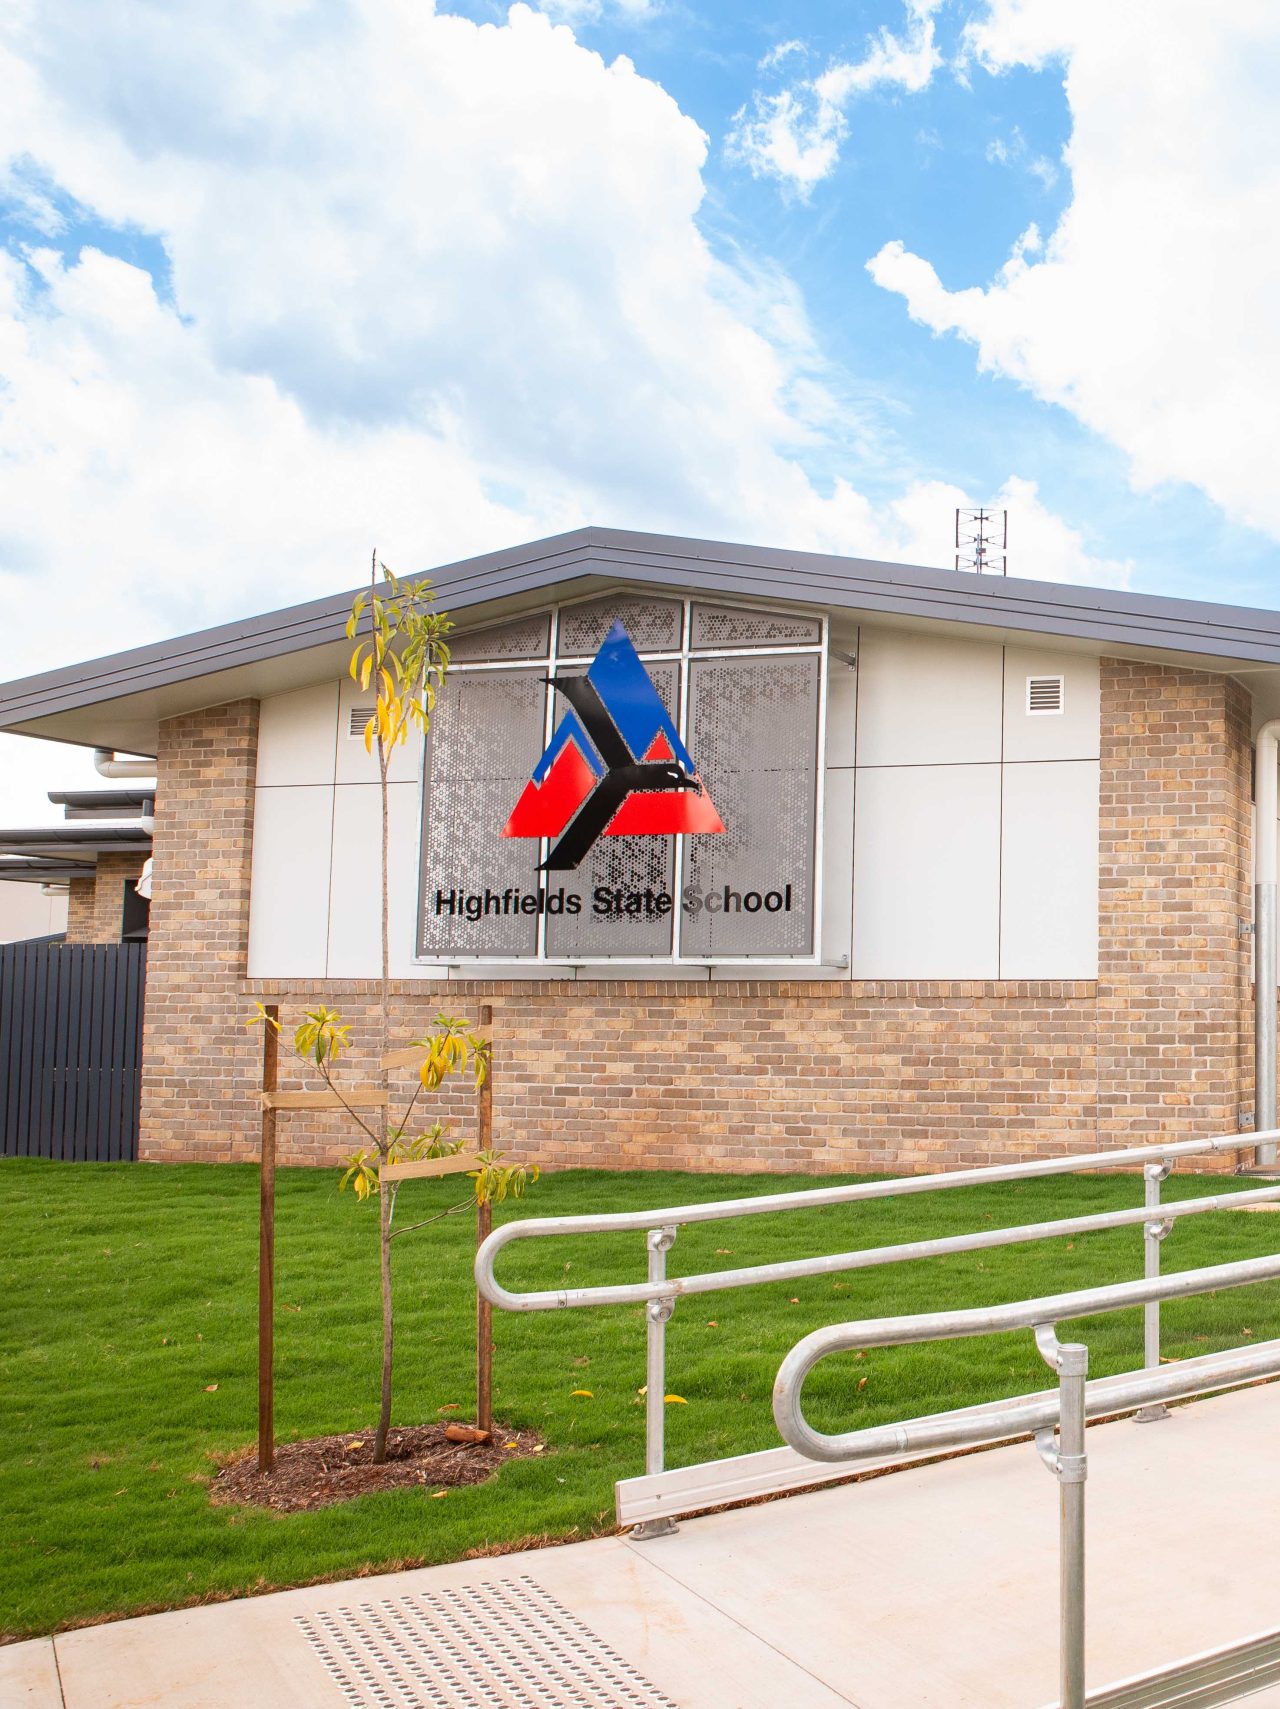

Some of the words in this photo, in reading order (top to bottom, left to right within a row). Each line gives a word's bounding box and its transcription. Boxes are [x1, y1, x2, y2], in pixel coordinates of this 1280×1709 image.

[435, 888, 582, 921] Highfields
[592, 886, 672, 915] State
[682, 884, 792, 914] School
